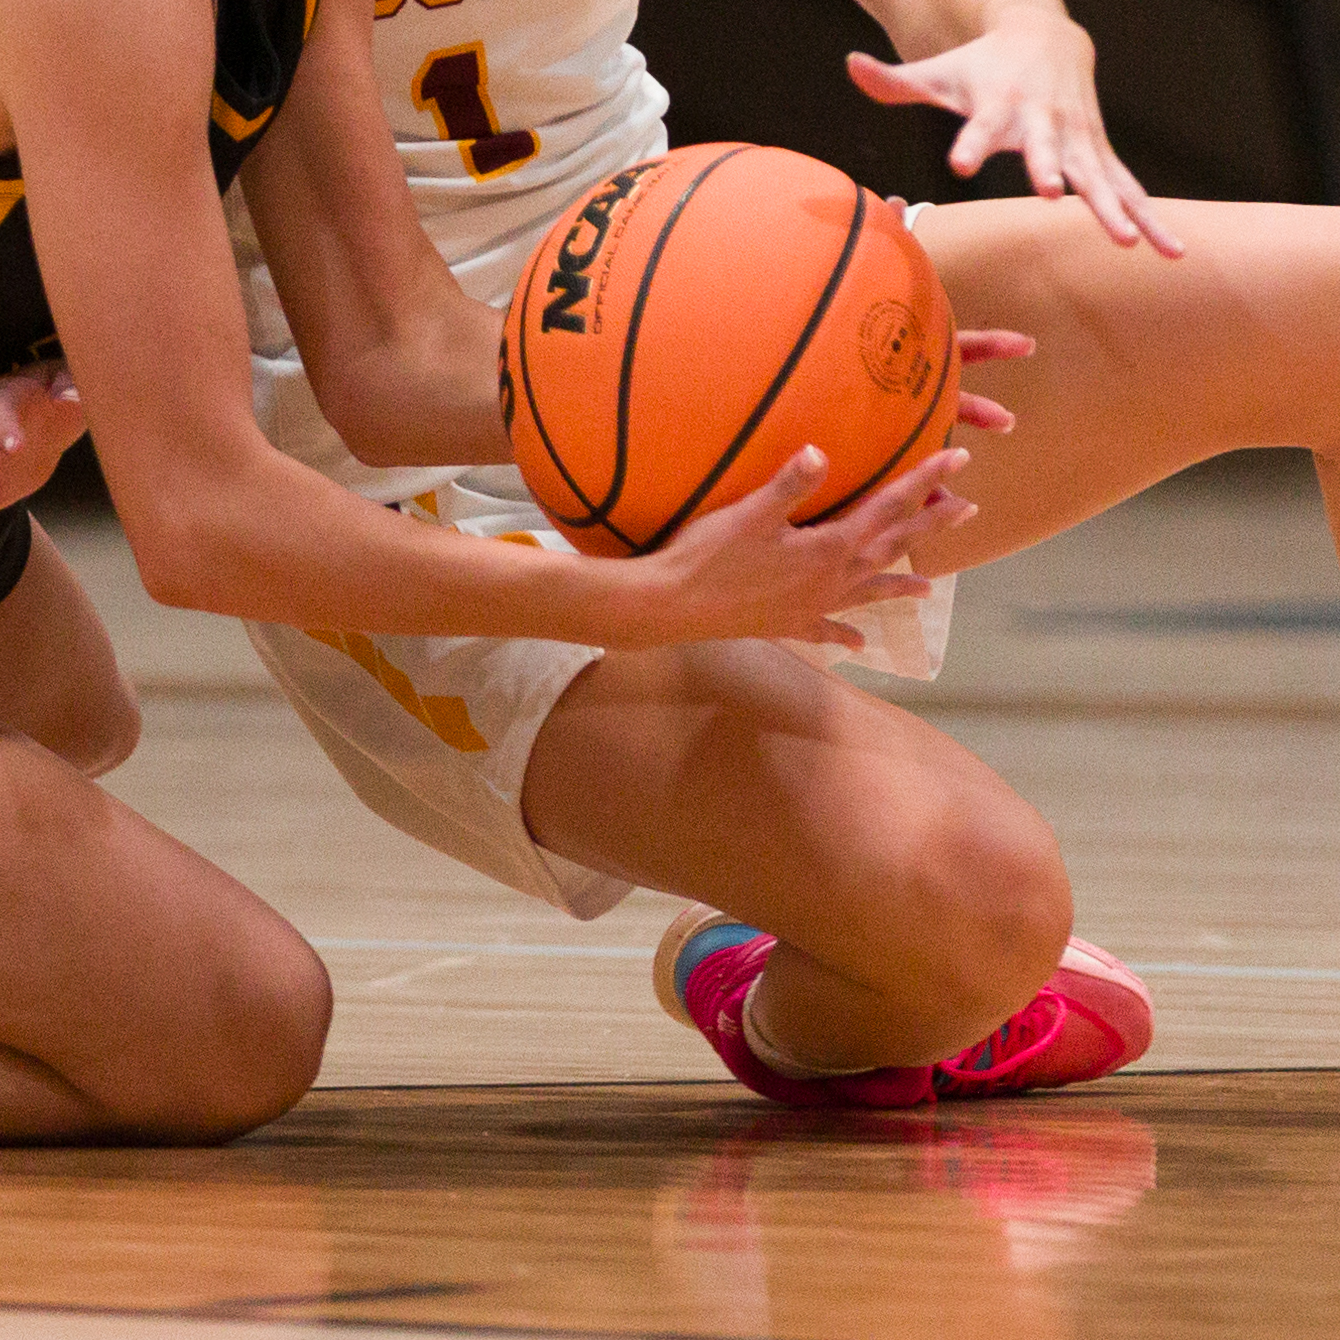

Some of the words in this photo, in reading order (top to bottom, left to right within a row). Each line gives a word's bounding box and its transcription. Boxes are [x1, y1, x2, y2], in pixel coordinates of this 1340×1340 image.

[411, 39, 541, 184] 1
[541, 161, 664, 334] NCAA
[593, 243, 620, 335] OFFICIAL
